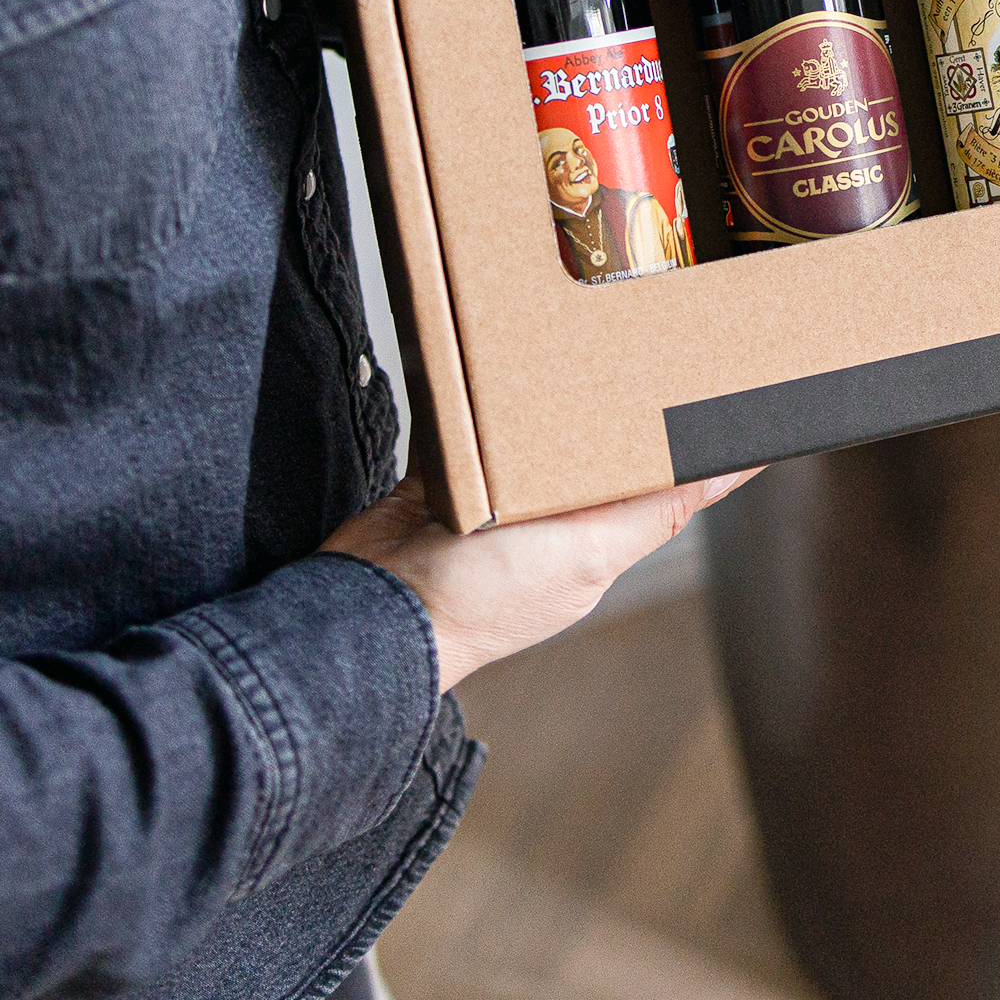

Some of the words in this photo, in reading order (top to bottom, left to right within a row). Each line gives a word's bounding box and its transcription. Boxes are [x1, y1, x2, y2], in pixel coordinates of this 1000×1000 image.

[942, 6, 952, 21] een
[564, 53, 602, 68] Abbey
[606, 48, 624, 60] Ale
[976, 67, 986, 92] Haver
[586, 102, 651, 134] Prior
[654, 94, 664, 120] 8
[785, 98, 868, 125] GOUDEN
[747, 110, 900, 162] CAROLUS
[964, 148, 973, 160] du
[792, 164, 884, 198] CLASSIC
[649, 258, 678, 273] BELGIUM
